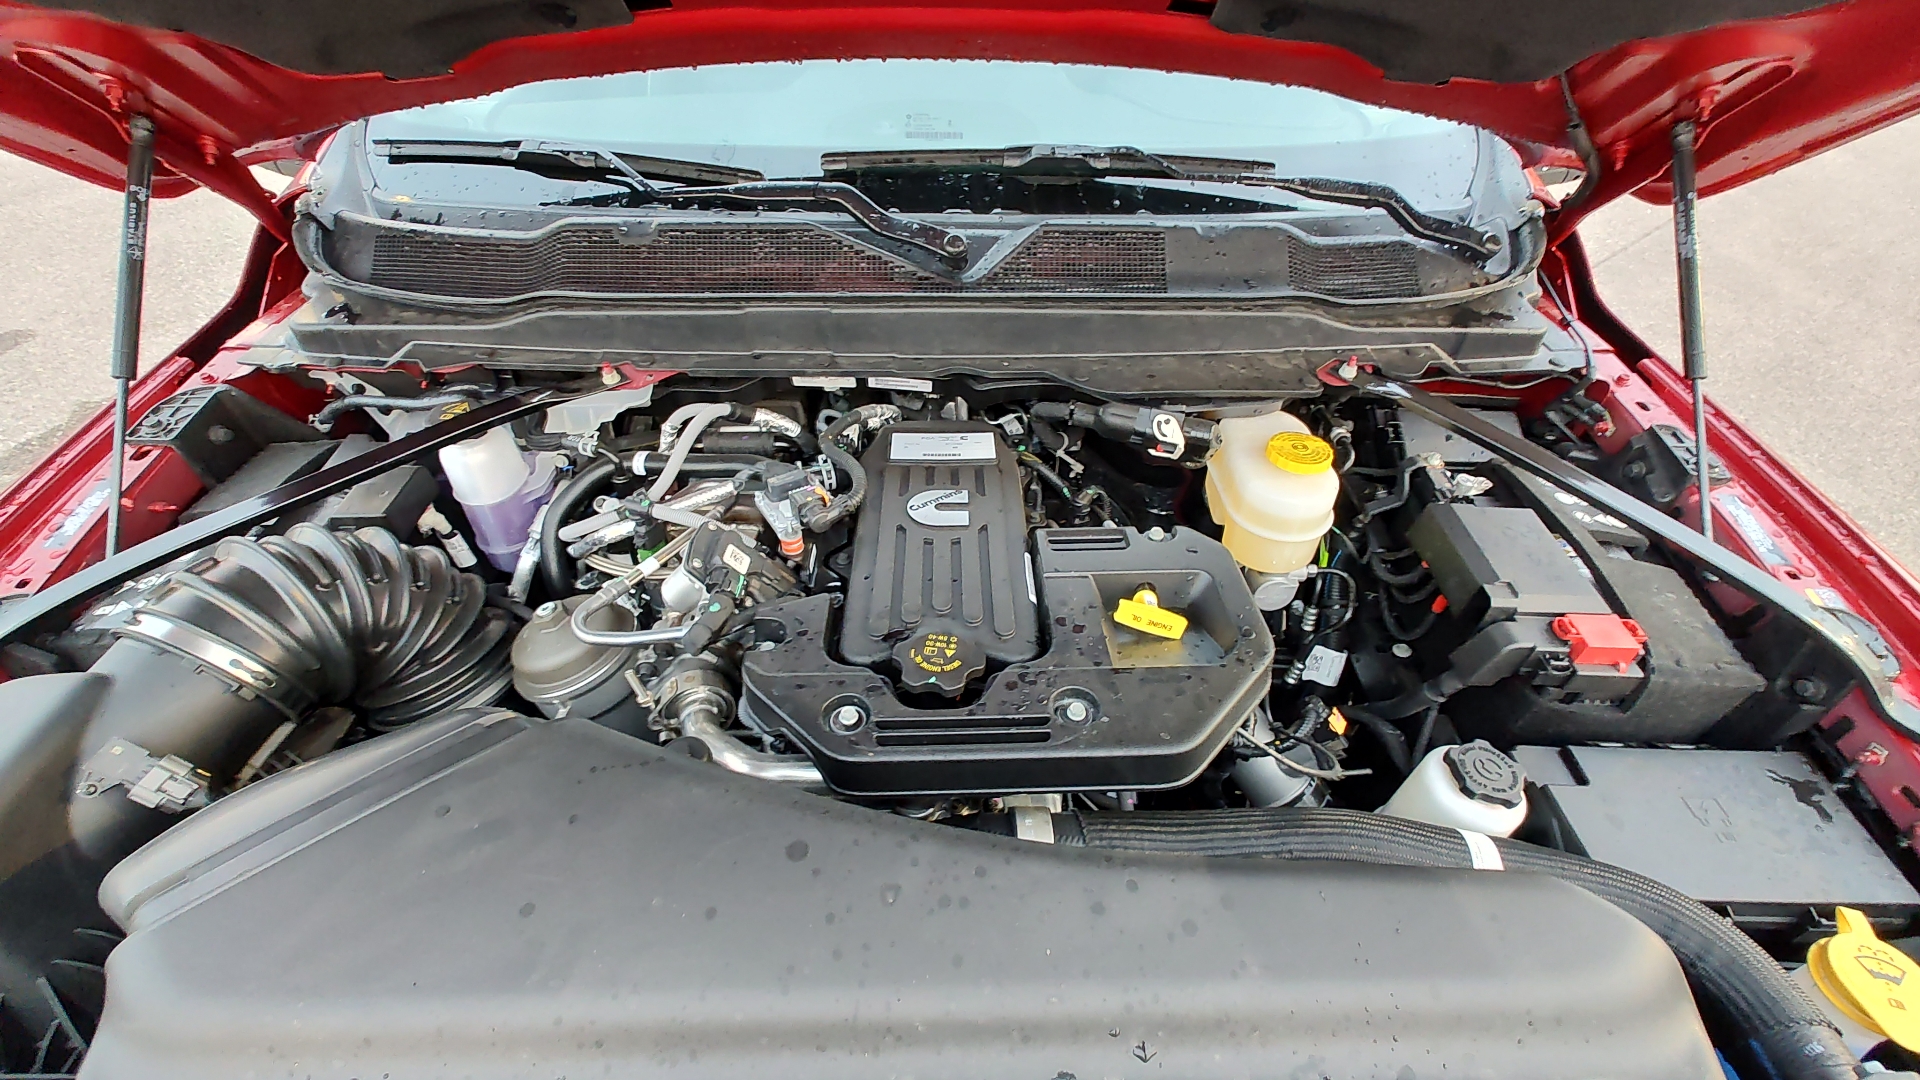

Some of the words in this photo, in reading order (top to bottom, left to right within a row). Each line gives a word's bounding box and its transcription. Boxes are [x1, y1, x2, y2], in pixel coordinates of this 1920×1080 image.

[909, 490, 963, 511] Cummins
[1131, 614, 1142, 623] OIL
[1146, 619, 1173, 632] ENGINE
